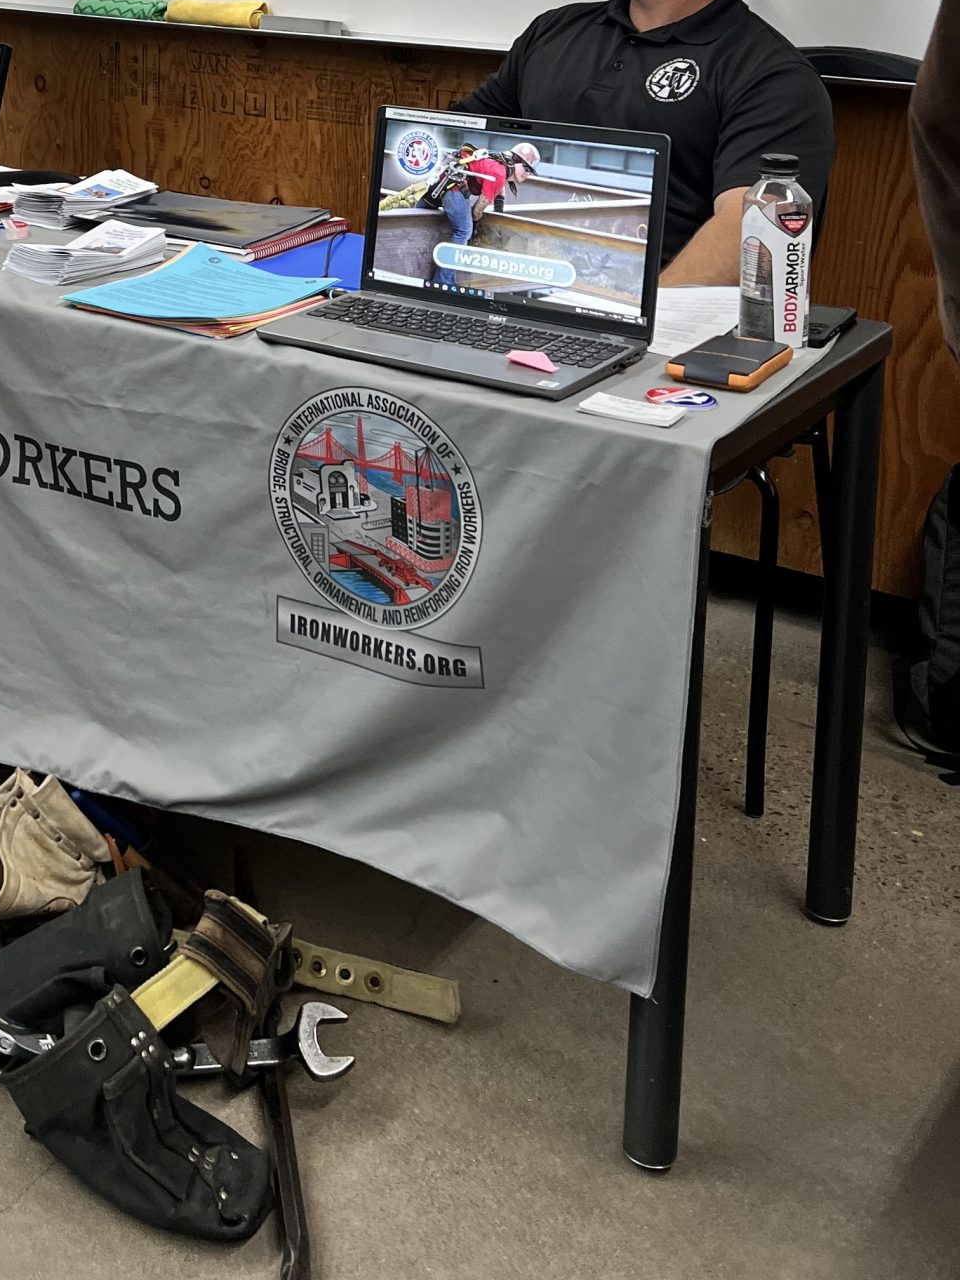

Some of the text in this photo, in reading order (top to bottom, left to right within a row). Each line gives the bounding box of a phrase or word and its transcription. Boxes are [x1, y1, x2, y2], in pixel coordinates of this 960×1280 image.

[192, 55, 230, 73] JAN
[783, 241, 800, 333] BODYARMOR
[290, 392, 456, 461] INTERNATIONAL ASSOCIATION OF
[271, 448, 479, 627] BRIDGE, STRUCTURAL, ORNAMENTAL AND REINFORCING IRON WORKERS
[289, 613, 467, 678] IRONWORKERS.ORG
